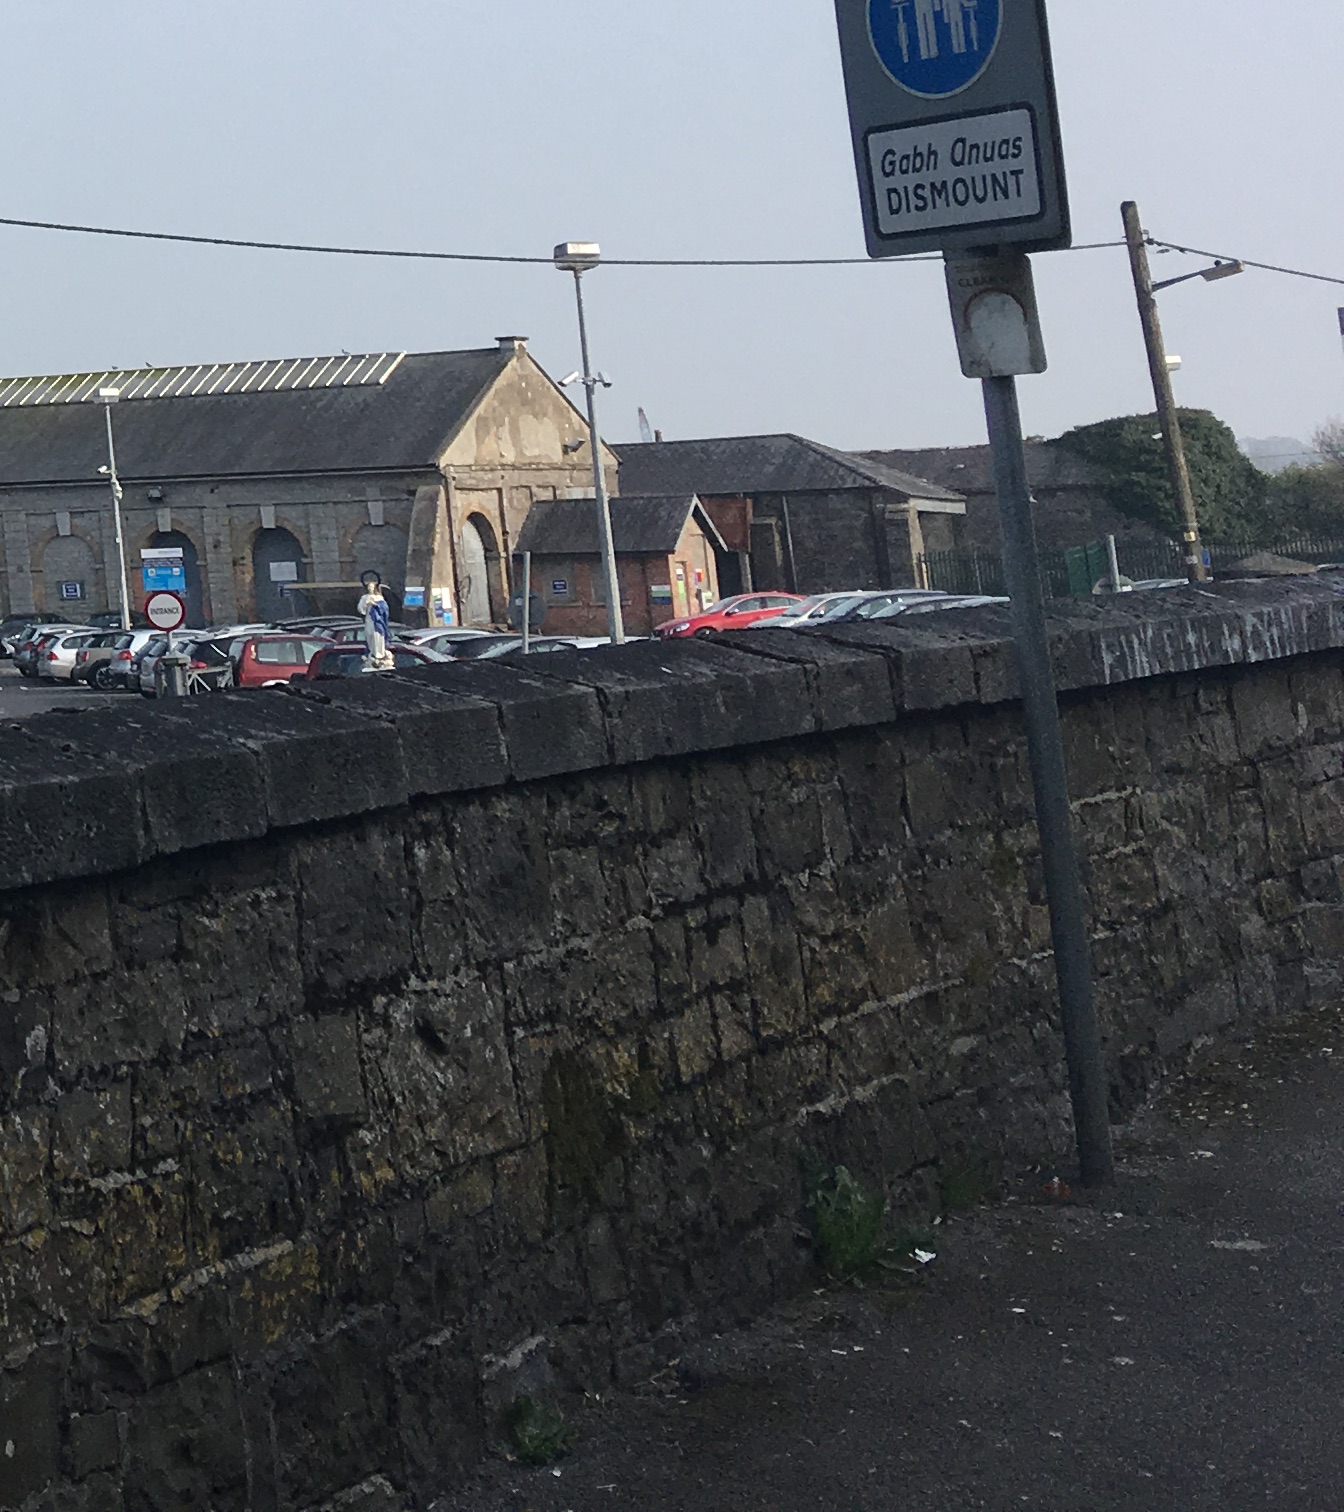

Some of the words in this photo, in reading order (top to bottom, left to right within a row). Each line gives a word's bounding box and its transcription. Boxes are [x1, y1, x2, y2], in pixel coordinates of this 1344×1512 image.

[881, 142, 938, 178] Gabh
[950, 136, 1023, 167] Anuas
[886, 168, 1024, 216] DISMOUNT
